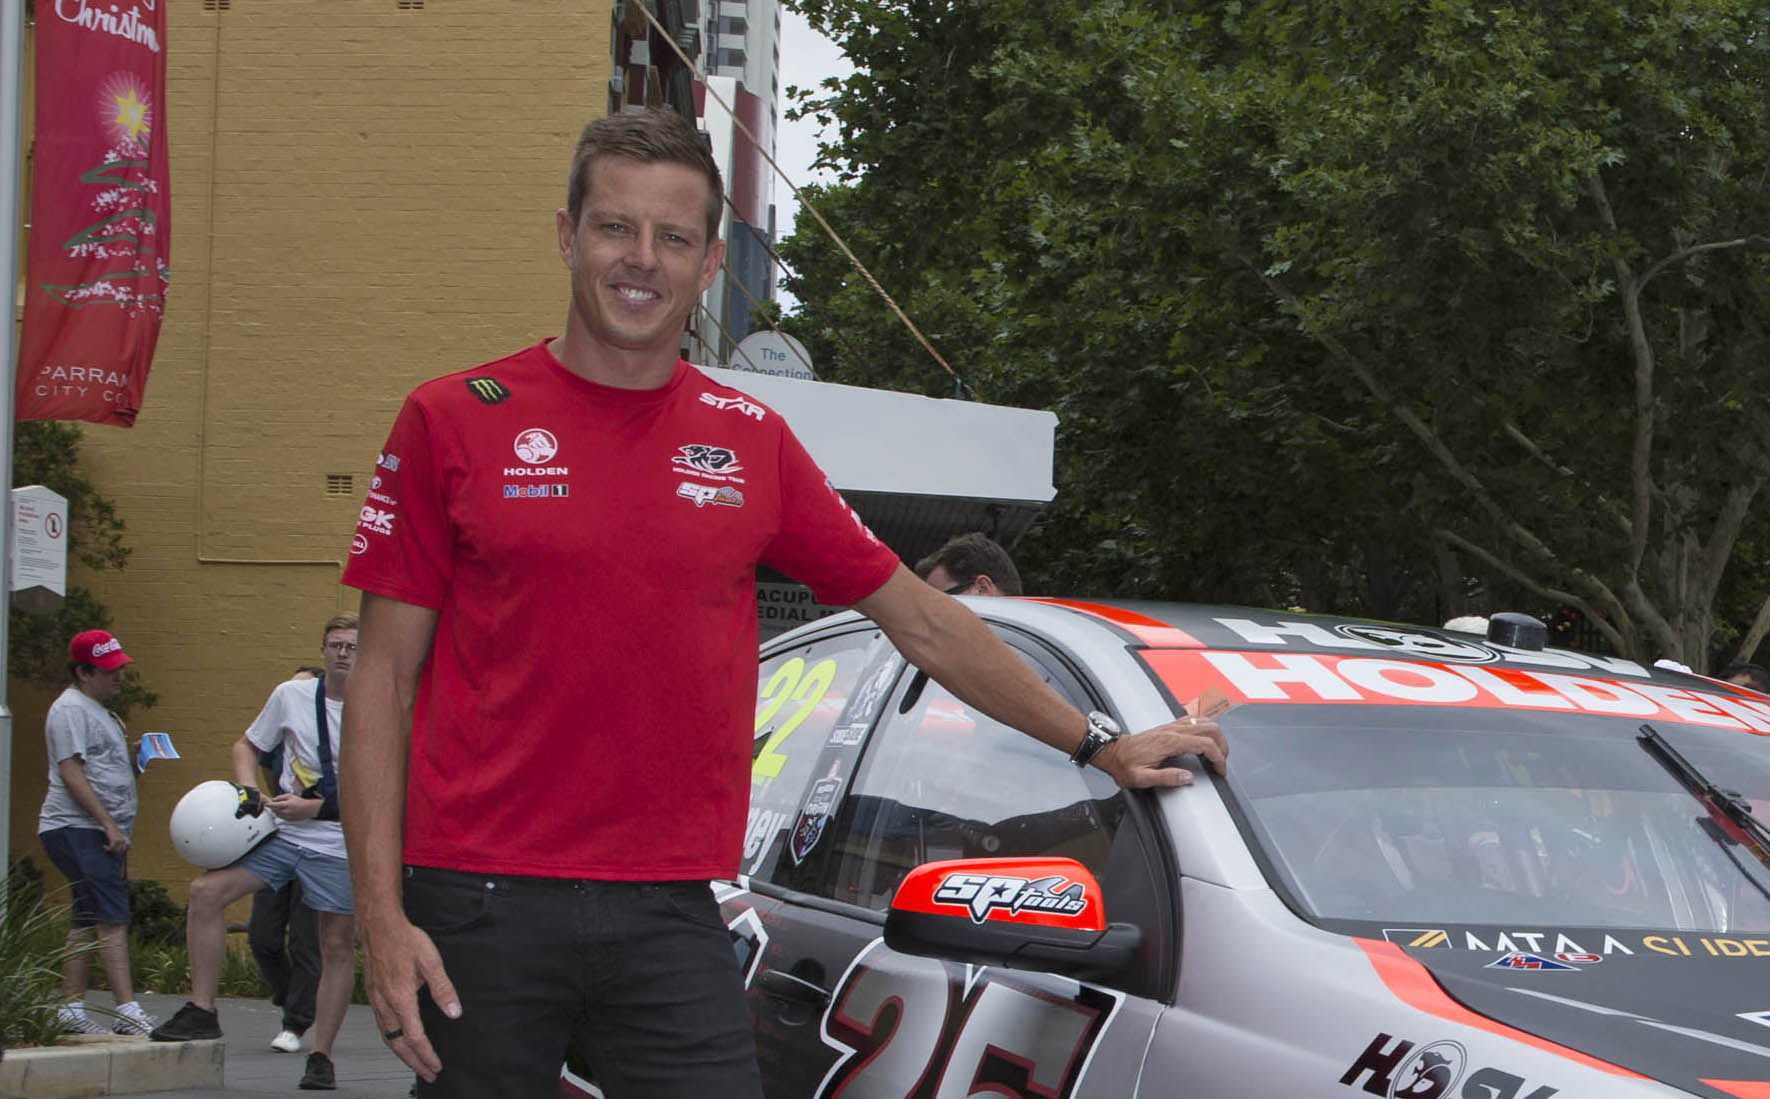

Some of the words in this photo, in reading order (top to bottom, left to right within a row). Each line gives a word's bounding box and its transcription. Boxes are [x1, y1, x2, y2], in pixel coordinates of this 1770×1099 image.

[760, 347, 786, 361] The
[34, 385, 88, 398] CITY
[699, 392, 766, 421] STAR
[504, 467, 568, 476] HOLDEN
[504, 484, 549, 498] Mobil
[934, 873, 1031, 923] SP
